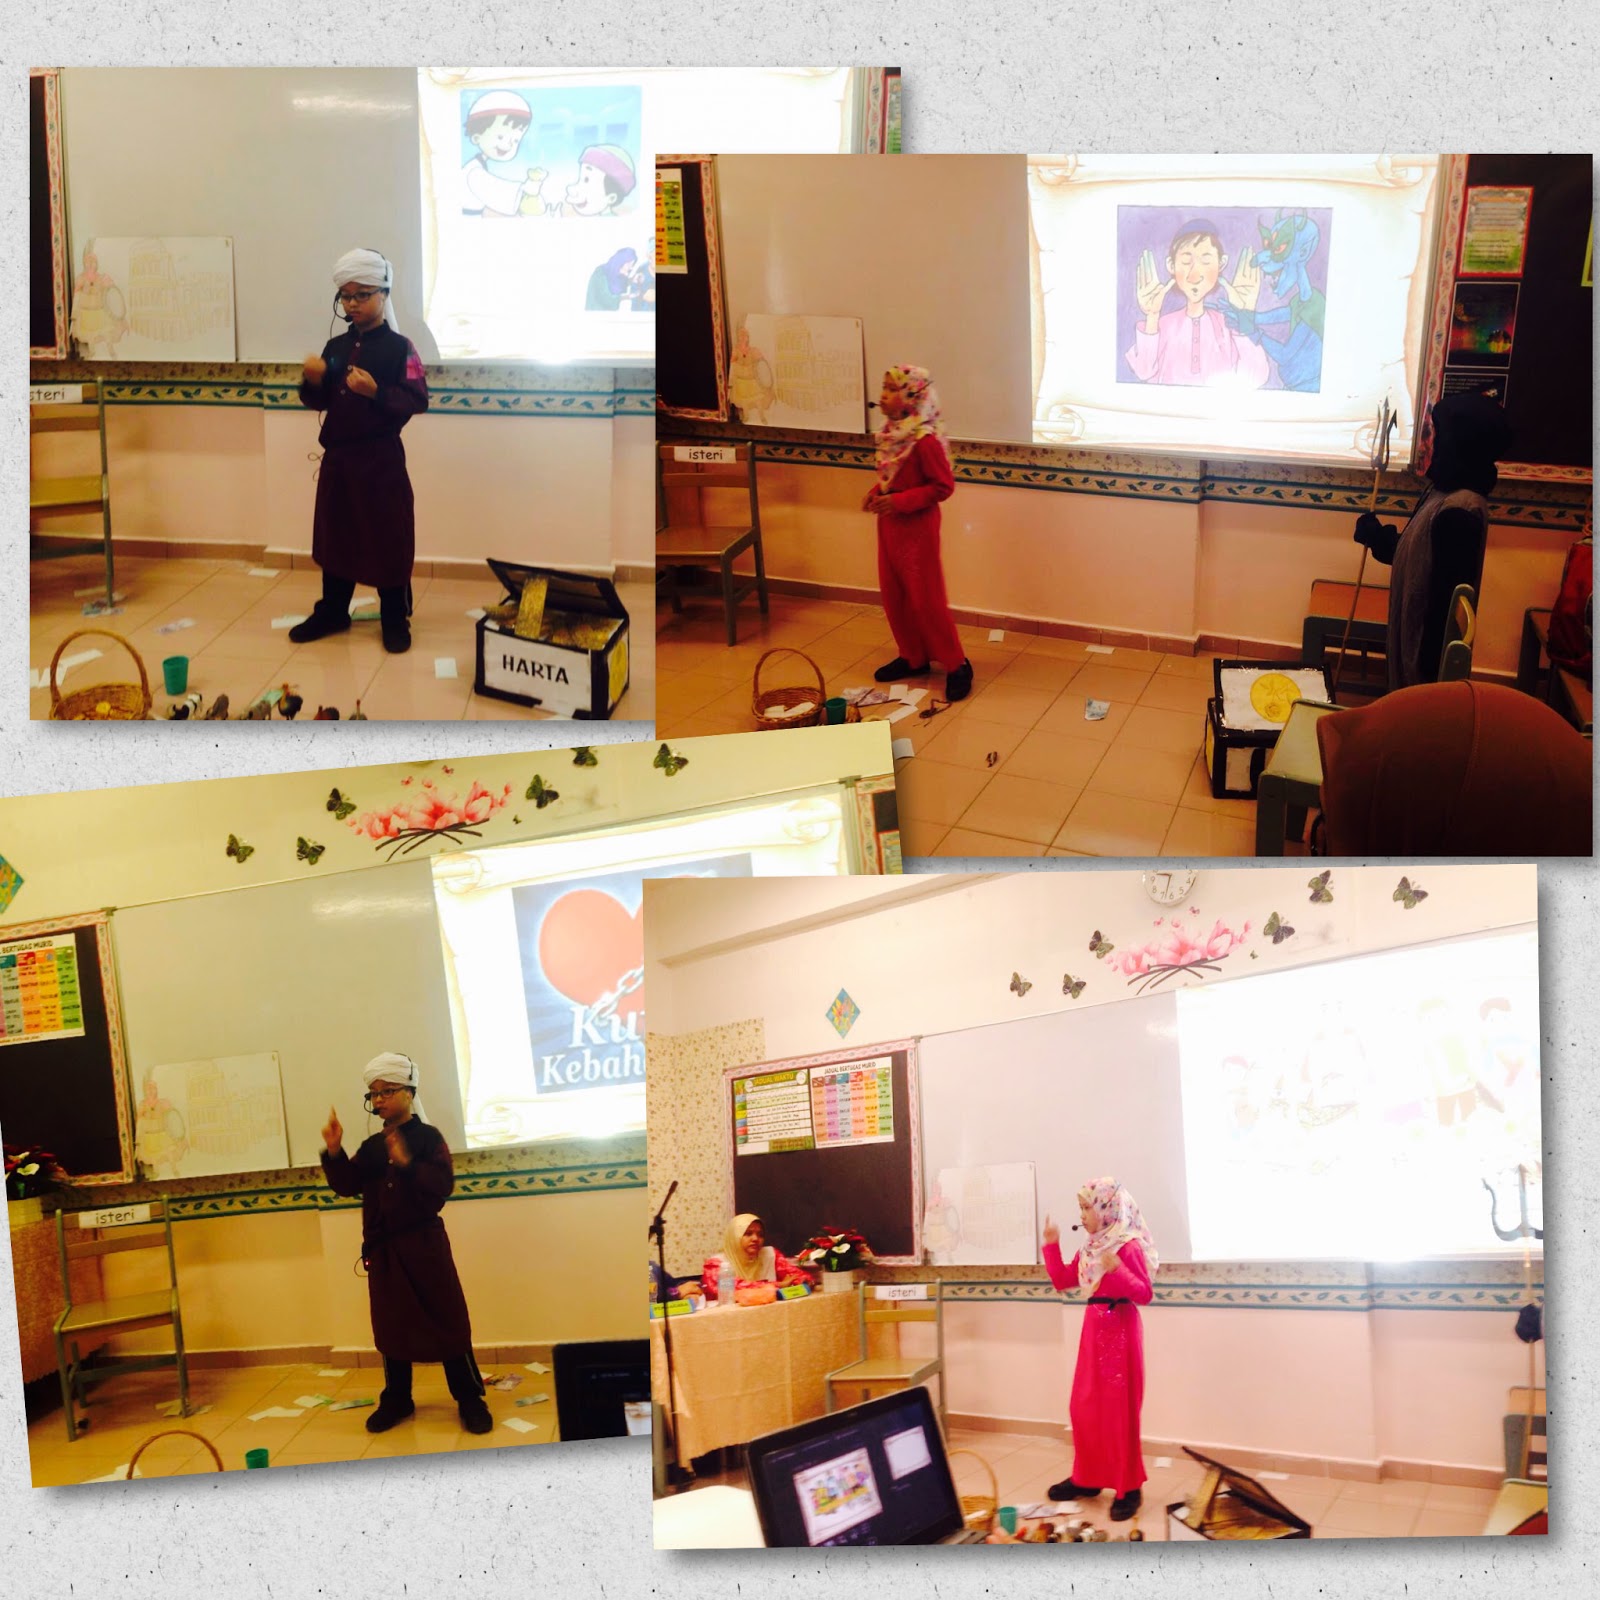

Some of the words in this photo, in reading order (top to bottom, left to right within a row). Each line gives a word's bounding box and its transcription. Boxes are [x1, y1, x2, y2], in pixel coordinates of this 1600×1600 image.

[689, 449, 723, 460] isteri
[503, 654, 569, 685] HARTA
[568, 1005, 646, 1048] Ku
[541, 1043, 646, 1086] Kebah
[95, 1208, 135, 1225] isteri
[888, 1287, 916, 1298] isteri
